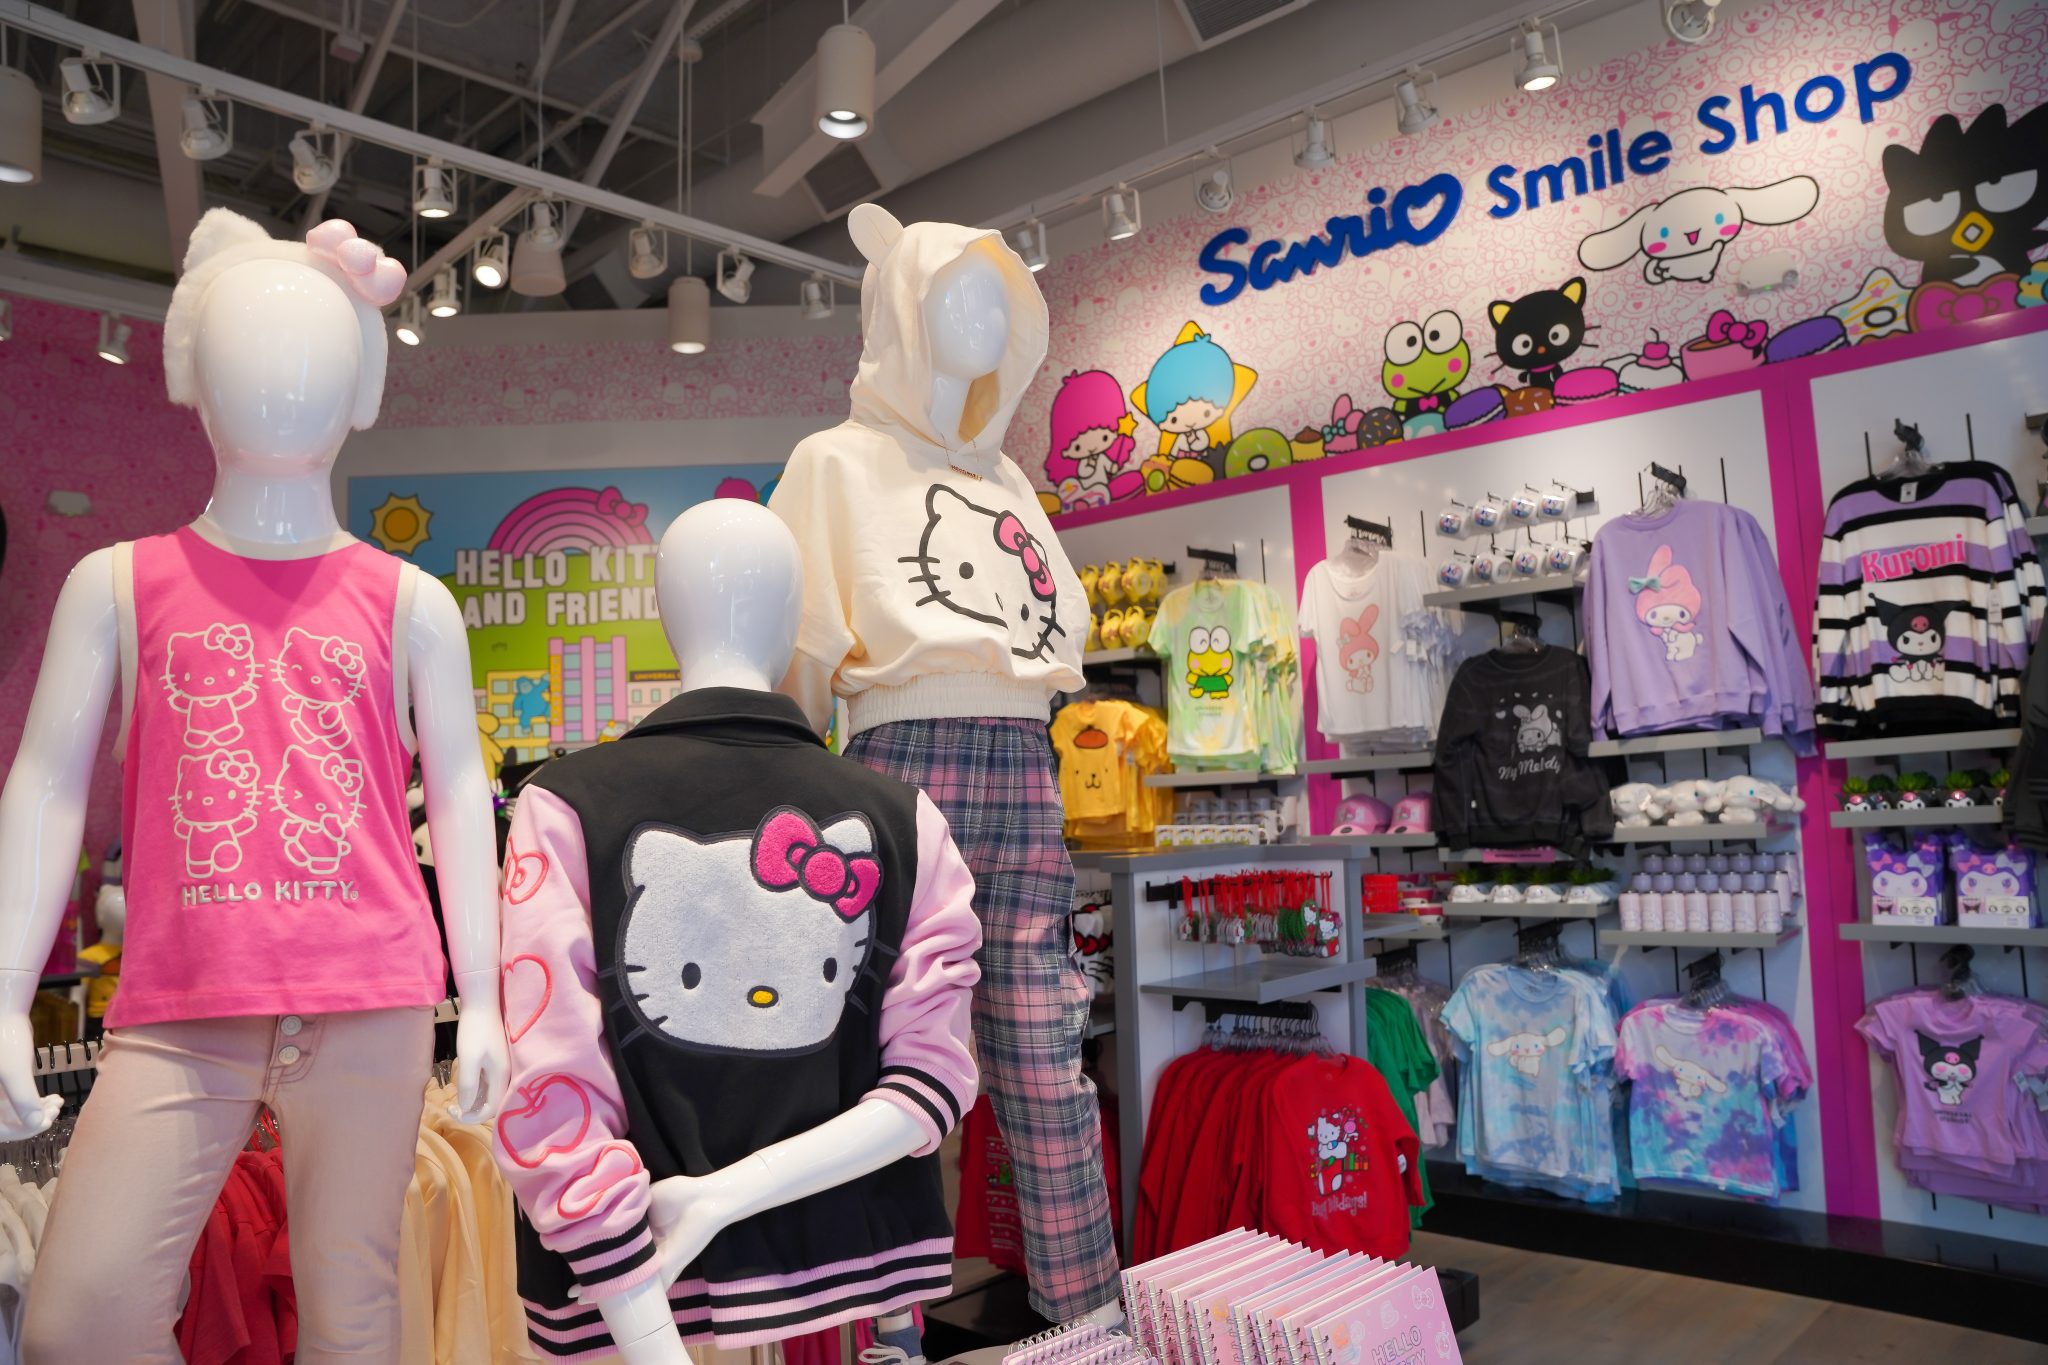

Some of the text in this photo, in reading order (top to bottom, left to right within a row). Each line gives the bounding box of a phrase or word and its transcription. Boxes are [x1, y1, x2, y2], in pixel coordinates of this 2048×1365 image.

[1199, 52, 1912, 306] Sanrio Smile Shop
[456, 544, 658, 589] HELLO KIT
[1861, 533, 1967, 583] Kuromi
[464, 587, 660, 629] AND FRIEND
[182, 880, 354, 906] HELLO KITTY
[1371, 1325, 1421, 1365] HELLO
